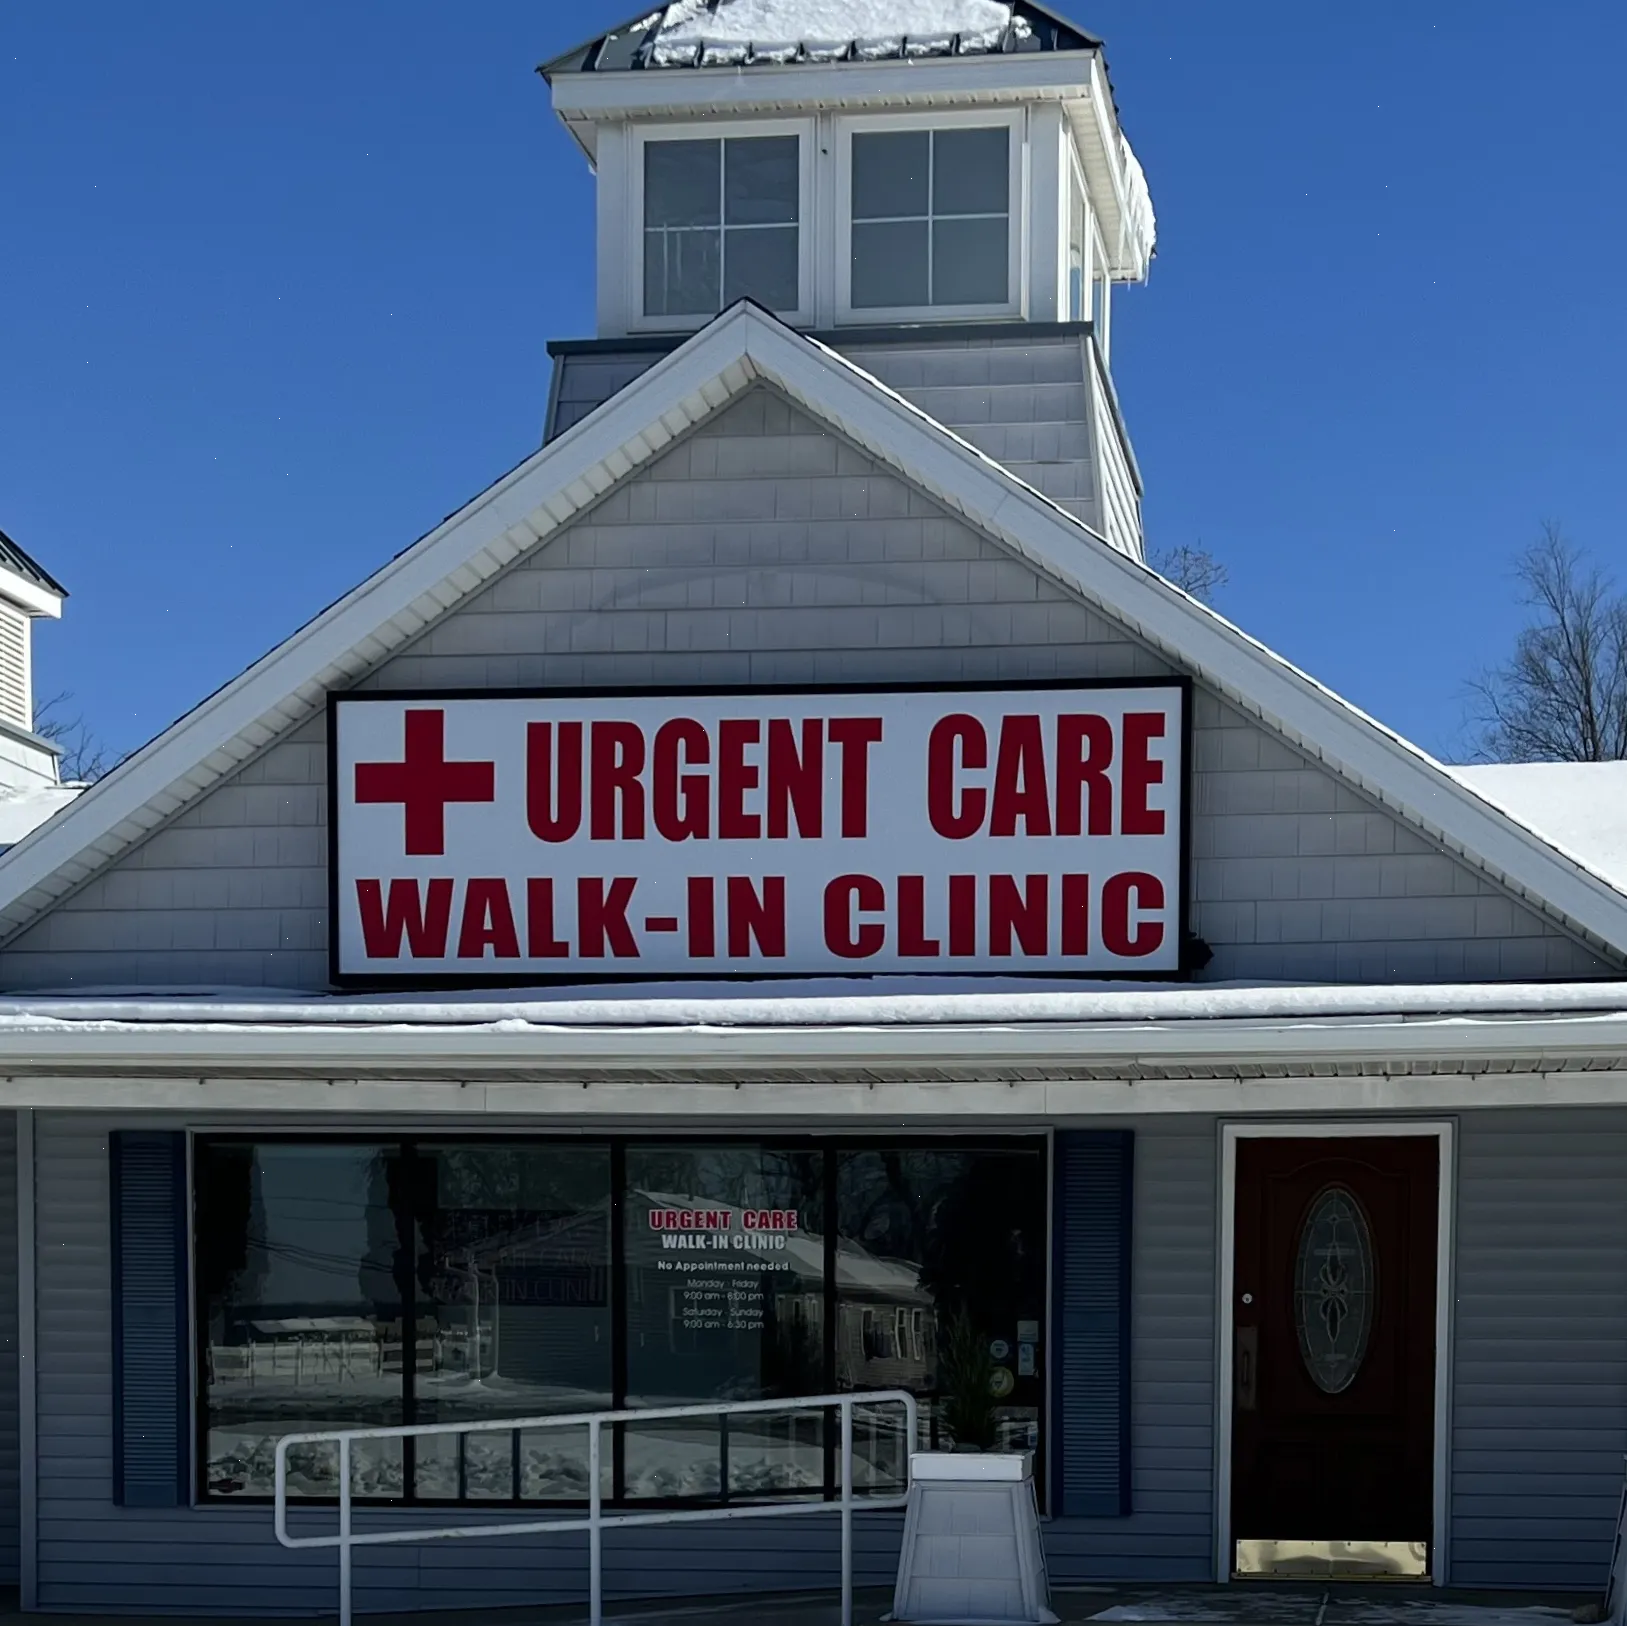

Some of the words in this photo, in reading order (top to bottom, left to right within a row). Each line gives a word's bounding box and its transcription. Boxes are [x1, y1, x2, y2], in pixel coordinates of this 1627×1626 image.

[526, 716, 883, 843] URGENT
[927, 712, 1166, 840] CARE
[354, 874, 786, 960] WALK-IN
[823, 870, 1165, 960] CLINIC
[649, 1209, 733, 1231] URGENT
[741, 1209, 798, 1231] CARE
[661, 1234, 730, 1250] WALK-IN
[733, 1234, 787, 1250] CLINIC
[658, 1260, 673, 1271] No
[675, 1260, 745, 1272] Appointment
[746, 1260, 789, 1271] needed
[687, 1279, 725, 1289] Monday
[732, 1279, 759, 1290] Friday
[704, 1292, 721, 1300] am
[748, 1292, 764, 1301] pm
[682, 1307, 723, 1317] Saturday
[730, 1307, 764, 1318] Sunday
[704, 1321, 721, 1329] am
[748, 1321, 764, 1330] pm
